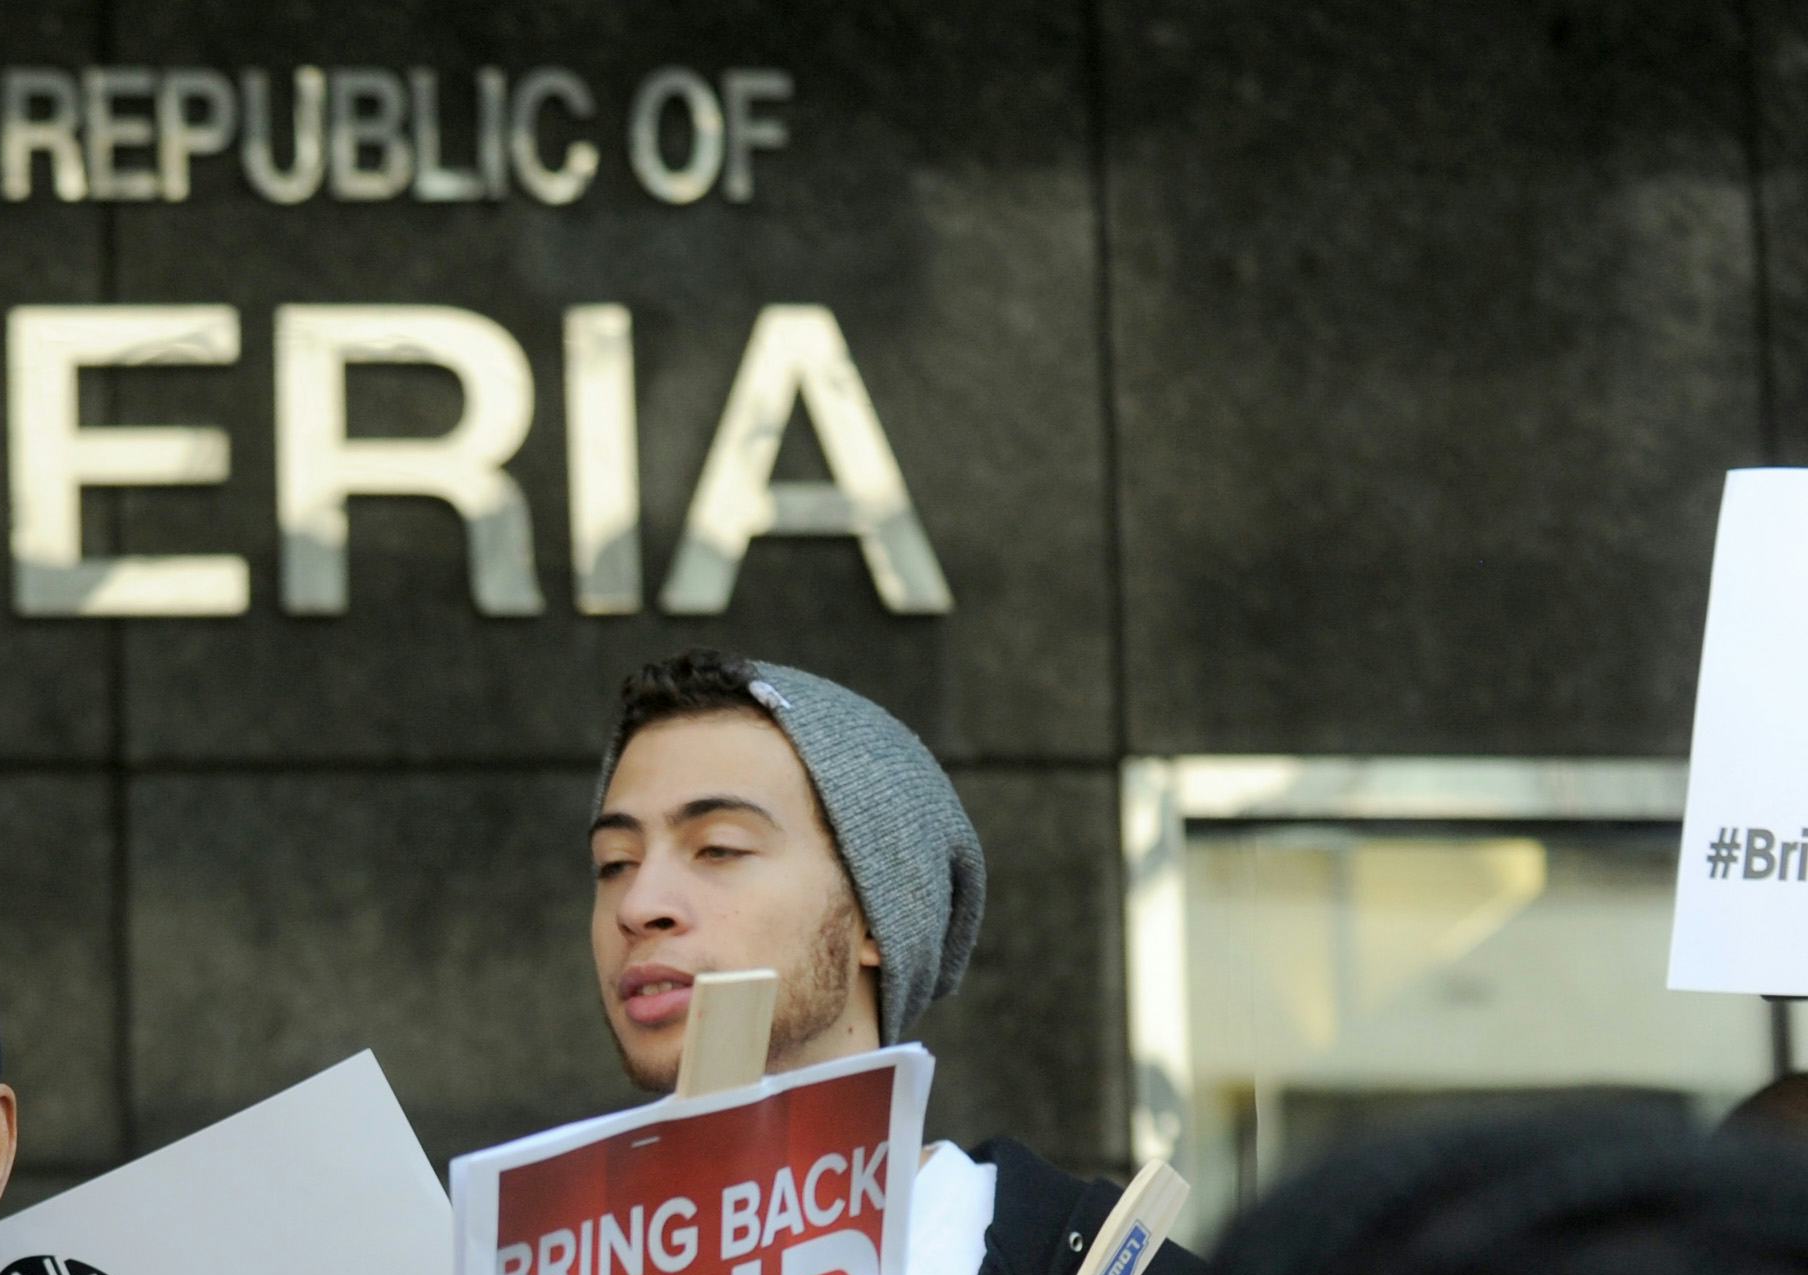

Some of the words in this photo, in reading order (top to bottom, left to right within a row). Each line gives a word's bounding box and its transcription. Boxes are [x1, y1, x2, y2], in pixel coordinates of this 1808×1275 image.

[0, 66, 599, 204] REPUBLIC
[628, 66, 795, 204] OF
[1706, 827, 1808, 882] #Bri
[720, 1140, 892, 1262] BACK
